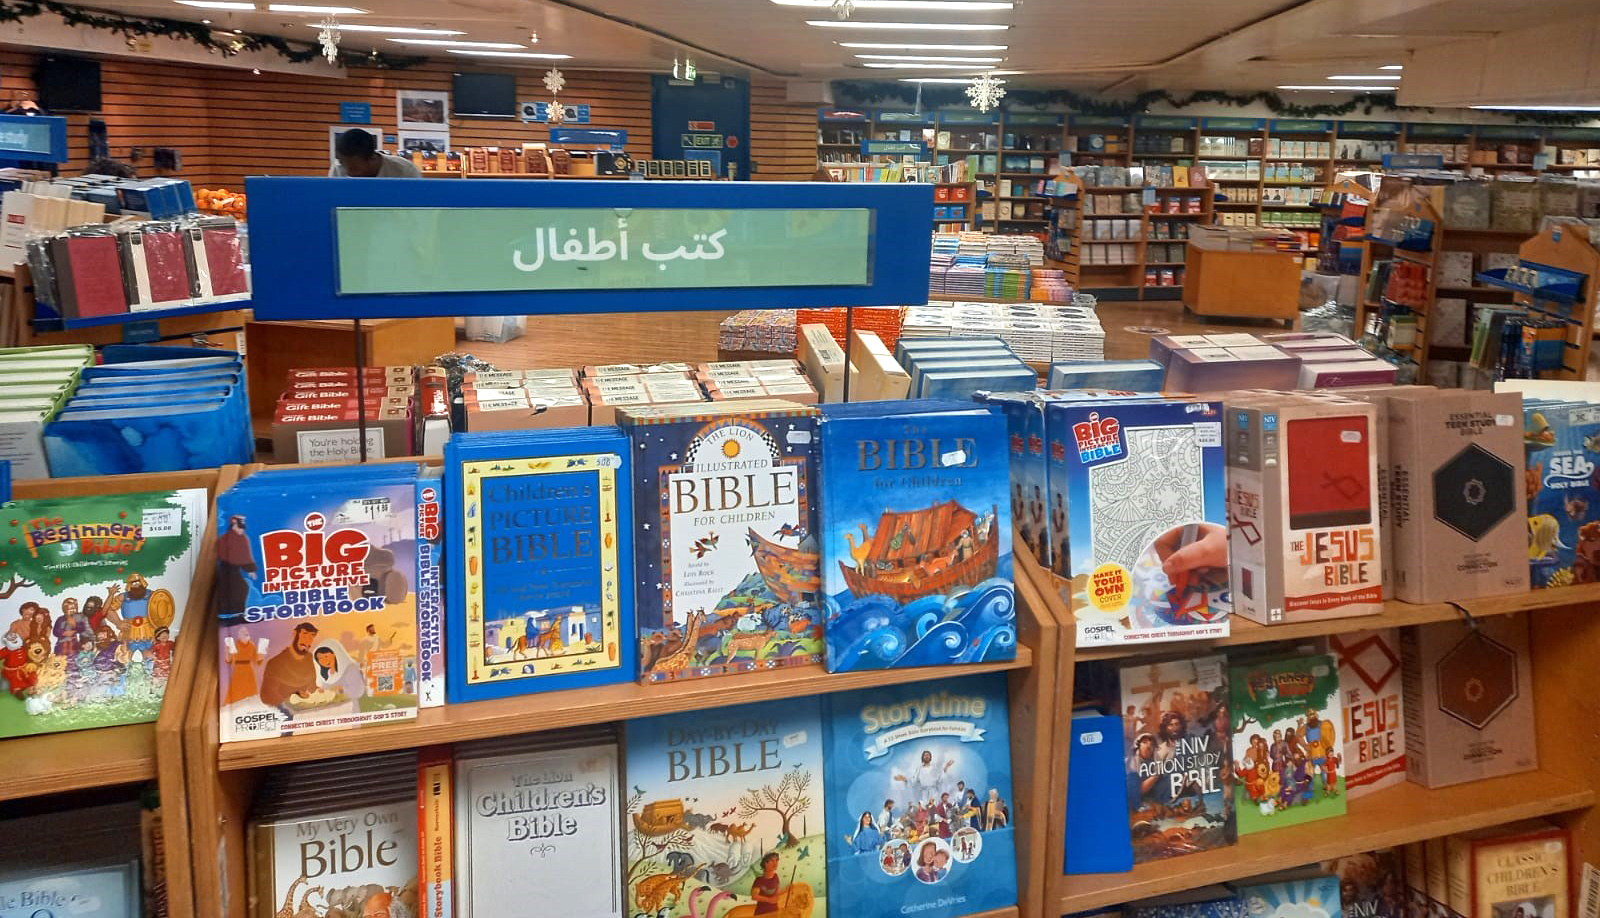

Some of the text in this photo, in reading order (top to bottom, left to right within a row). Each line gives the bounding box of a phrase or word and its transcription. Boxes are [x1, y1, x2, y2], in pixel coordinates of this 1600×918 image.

[512, 217, 727, 272] كتب أطفال
[294, 391, 319, 399] Gift
[285, 402, 341, 411] Gift Bible
[1072, 417, 1120, 442] BIG
[1264, 415, 1275, 423] NIV
[309, 438, 338, 448] You're
[706, 428, 755, 446] THE LION
[1078, 433, 1119, 447] PICTURE
[309, 448, 324, 457] the
[327, 447, 349, 457] Holy
[856, 437, 979, 472] BIBLE
[1080, 443, 1122, 463] BIBLE
[696, 459, 769, 473] ILLUSTRATED
[1550, 455, 1594, 477] SEA
[488, 481, 592, 503] Children's
[671, 471, 796, 515] BIBLE
[30, 516, 64, 529] The
[424, 502, 439, 539] BIG
[489, 505, 593, 532] PICTURE
[693, 511, 776, 527] FOR CHILDREN
[32, 522, 144, 548] Beginner's
[260, 528, 371, 570] BIG
[492, 529, 593, 565] BIBLE
[1290, 529, 1374, 566] THE JESUS
[262, 574, 370, 593] INTERACTIVE
[265, 563, 365, 583] PICTURE
[1093, 571, 1114, 579] MAKE
[1093, 575, 1123, 588] YOUR
[1324, 562, 1369, 587] BIBLE
[284, 587, 349, 606] BIBLE
[1094, 583, 1125, 597] OWN
[1099, 593, 1122, 604] COVER
[246, 596, 387, 622] STORYBOOK
[419, 544, 432, 683] BIBLE STORYBOOK
[430, 565, 440, 655] INTERACTIVE
[1084, 625, 1115, 634] GOSPEL
[372, 661, 399, 670] FREE
[235, 713, 280, 725] GOSPEL
[280, 721, 315, 731] CONNECTING
[315, 719, 336, 727] CHRIST
[336, 715, 372, 725] THROUGHOUT
[860, 692, 986, 734] Storytime
[1343, 694, 1399, 743] JESUS
[235, 721, 277, 732] PROJECT
[1181, 734, 1210, 756] NIV
[1359, 731, 1396, 763] BIBLE
[667, 738, 782, 783] BIBLE
[1138, 750, 1221, 779] ACTION STUDY
[1170, 766, 1221, 798] BIBLE
[476, 782, 607, 817] Children's
[296, 809, 399, 842] My Very Own
[506, 813, 578, 842] Bible
[299, 829, 399, 879] Bible
[433, 836, 442, 864] Bible
[20, 890, 66, 908] Bible
[433, 865, 444, 918] Storybook
[901, 894, 967, 915] Catherine DeVries
[1353, 899, 1379, 918] NIV
